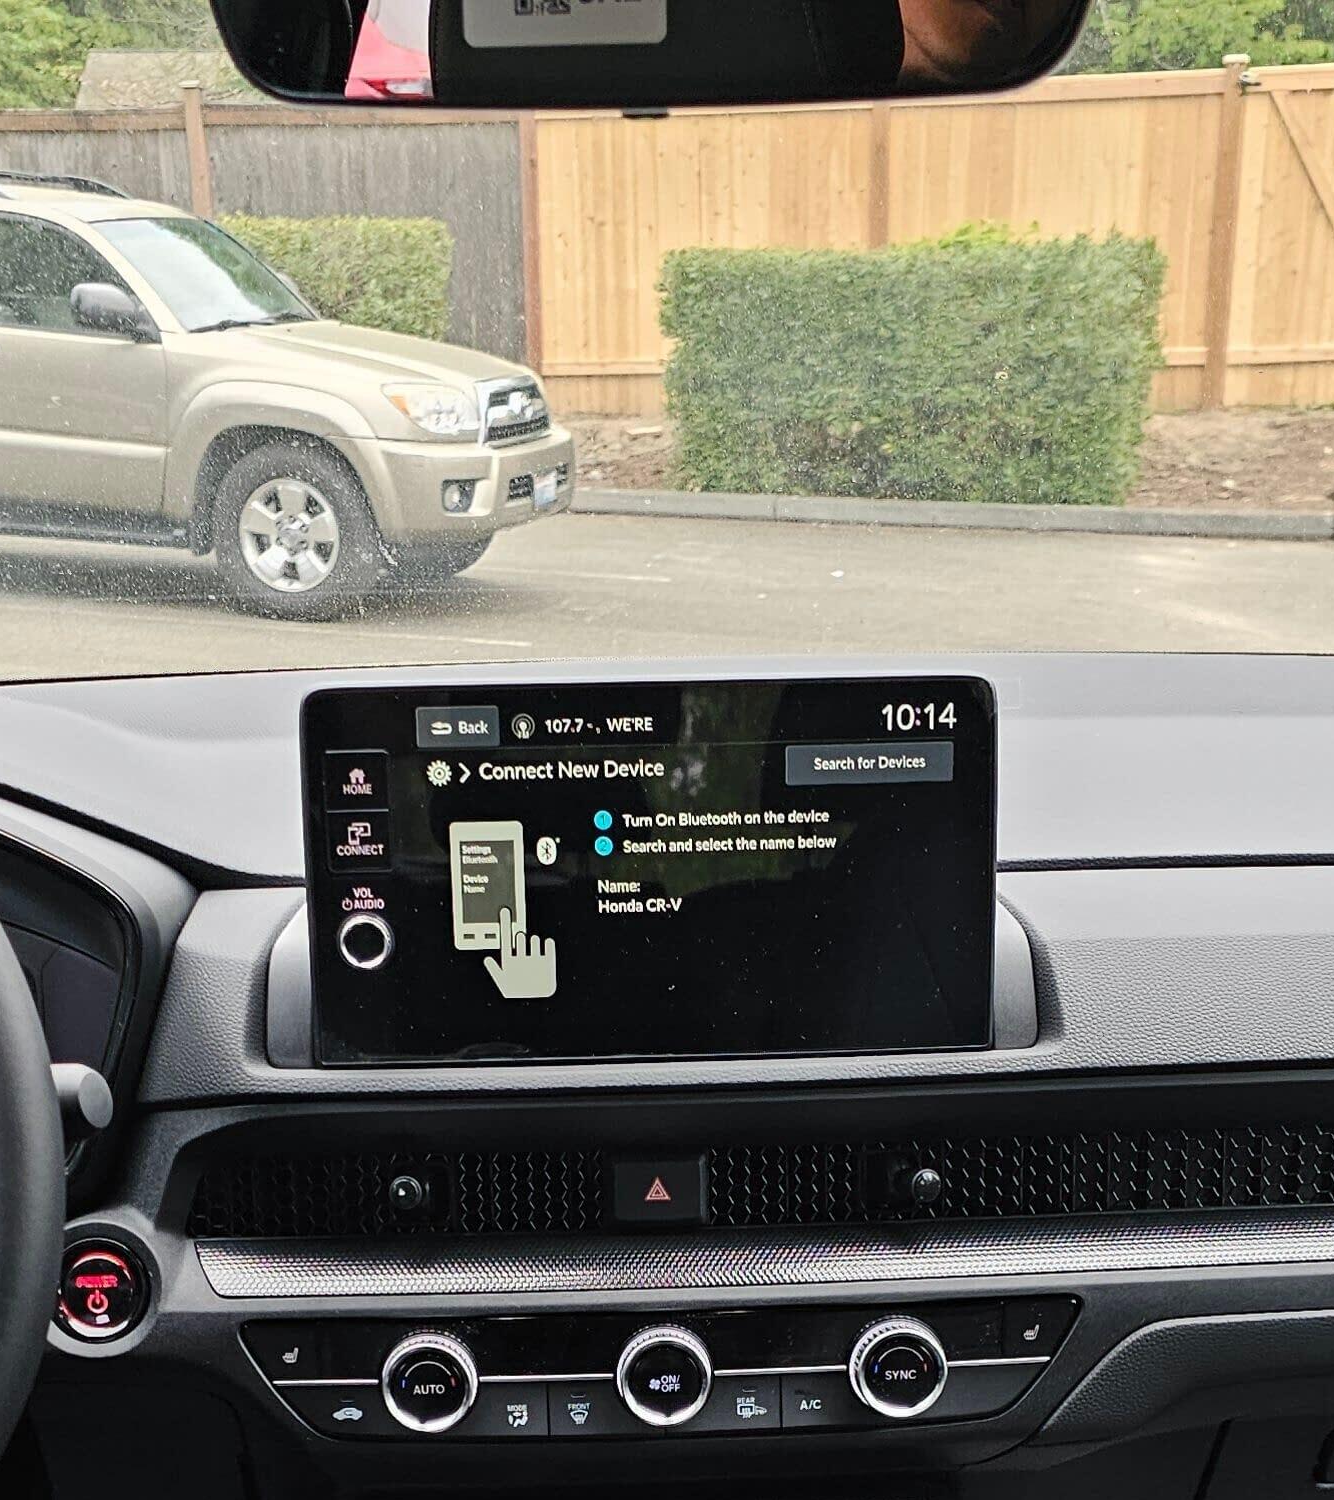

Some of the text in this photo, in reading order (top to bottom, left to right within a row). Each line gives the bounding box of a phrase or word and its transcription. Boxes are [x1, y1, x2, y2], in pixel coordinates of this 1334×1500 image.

[881, 702, 957, 731] 10:14
[458, 720, 489, 735] Back
[545, 717, 583, 734] 107.7
[606, 717, 653, 733] WE'RE
[814, 755, 926, 771] Search for Devices
[478, 759, 665, 781] Connect New Device
[342, 784, 373, 795] HOME
[622, 809, 830, 828] Turn On Bluetooth on the device
[336, 844, 384, 856] CONNECT
[623, 835, 837, 853] Search and select the name below
[353, 887, 374, 898] VOL
[597, 879, 641, 894] Name:
[353, 899, 385, 910] AUDIO
[598, 898, 682, 913] Honda CR-V
[661, 1374, 681, 1385] ON/
[885, 1369, 917, 1381] SYNC
[413, 1384, 445, 1396] AUTO
[662, 1383, 681, 1393] OFF
[507, 1404, 528, 1412] MODE
[568, 1403, 591, 1411] FRONT
[799, 1399, 822, 1411] A/C
